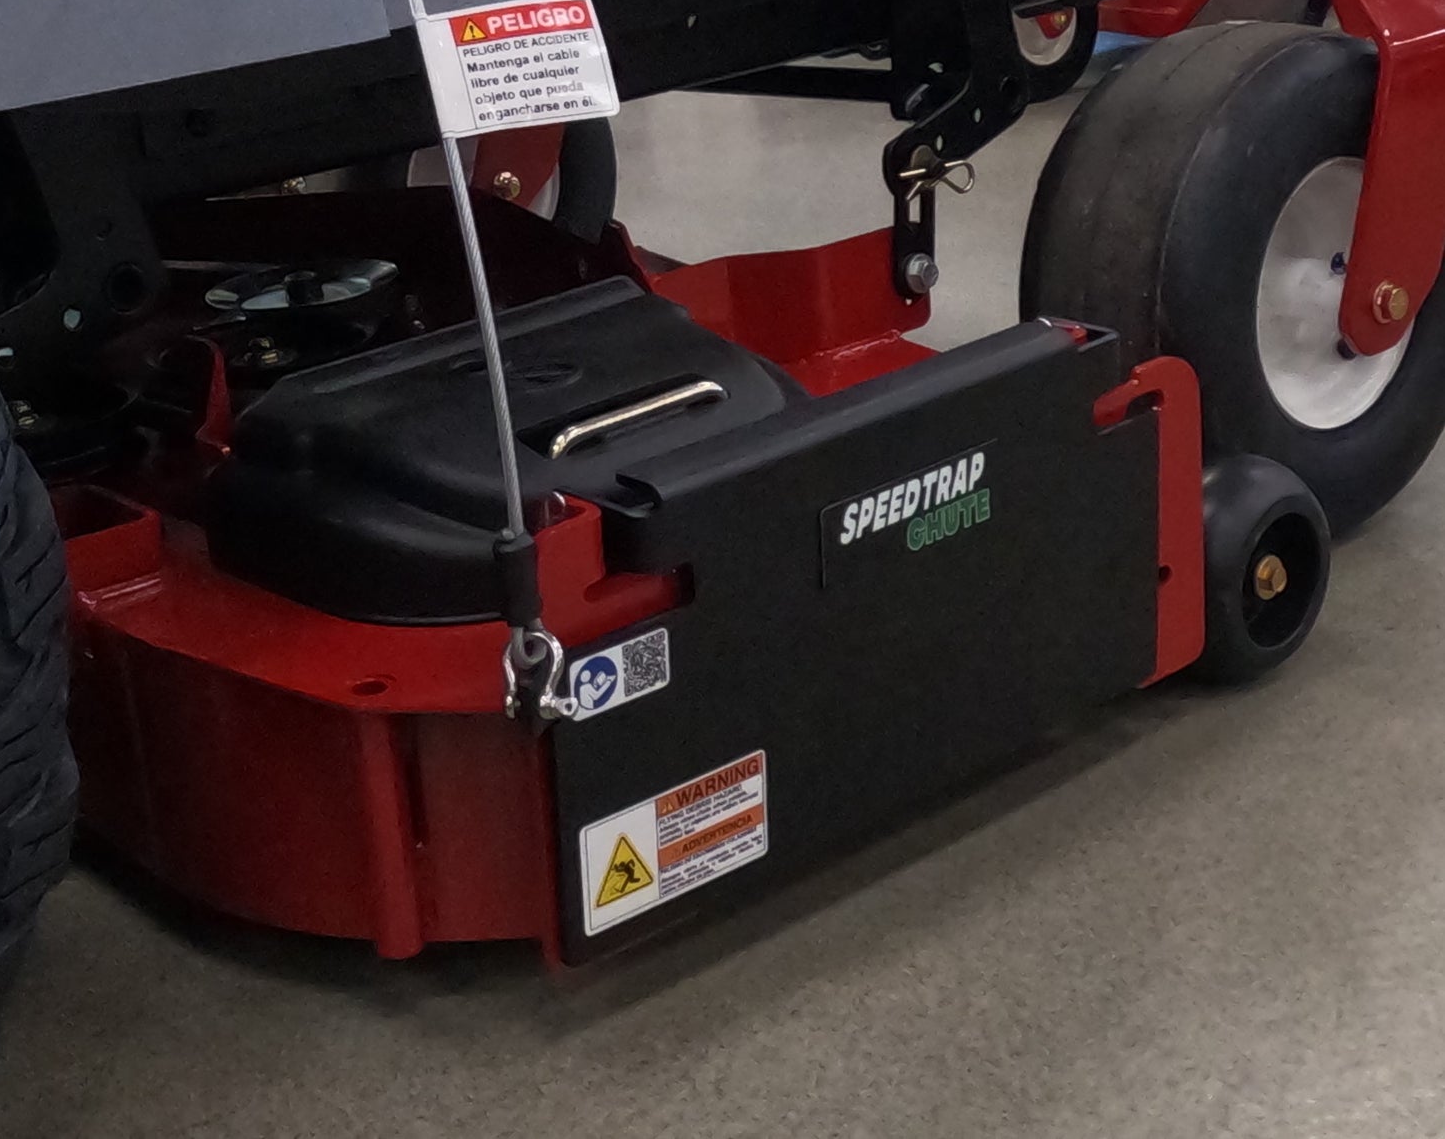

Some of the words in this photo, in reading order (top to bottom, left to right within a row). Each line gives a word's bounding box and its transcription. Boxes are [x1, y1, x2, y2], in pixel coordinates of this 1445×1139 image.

[487, 6, 585, 34] PELIGRO
[463, 41, 511, 57] PELIGRO
[514, 39, 529, 49] DE
[531, 32, 590, 46] ACCIDENTE
[467, 55, 530, 73] Mantenga
[533, 53, 544, 63] el
[547, 48, 580, 61] cable
[470, 76, 500, 89] libre
[503, 72, 519, 84] de
[522, 65, 580, 81] cualquier
[475, 90, 516, 105] objeto
[519, 87, 542, 100] que
[546, 80, 584, 97] pueda
[479, 101, 560, 121] engancharse
[563, 99, 579, 109] en
[840, 451, 986, 546] SPEEDTRAP
[907, 488, 991, 551] CHUTE
[675, 759, 759, 806] WARNING
[681, 814, 754, 853] ADVERTENCIA
